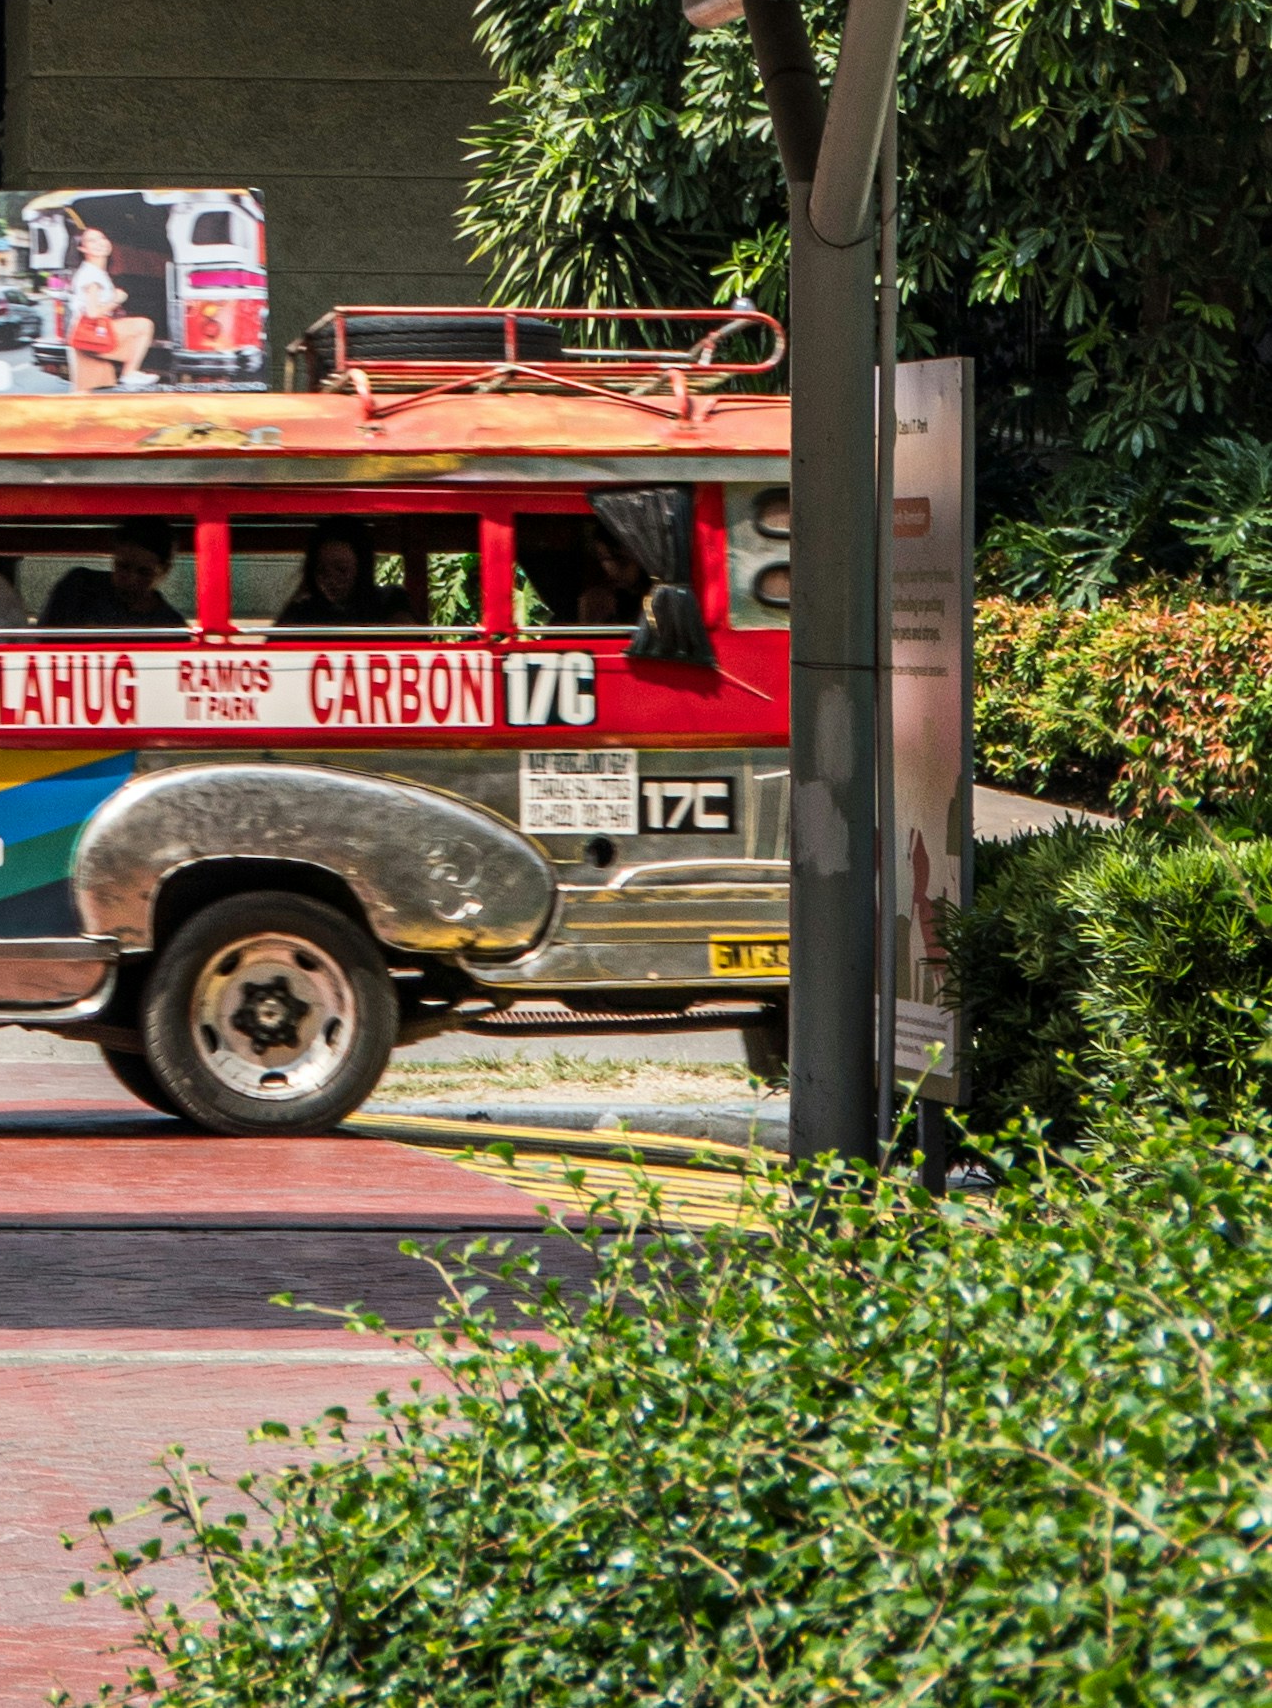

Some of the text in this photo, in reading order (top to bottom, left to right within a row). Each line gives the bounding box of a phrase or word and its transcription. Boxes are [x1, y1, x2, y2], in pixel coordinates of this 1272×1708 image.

[177, 659, 272, 695] RAMOS
[309, 653, 488, 725] CARBON
[502, 651, 595, 726] 17C
[185, 696, 259, 721] IT PARK
[642, 781, 729, 829] 17C
